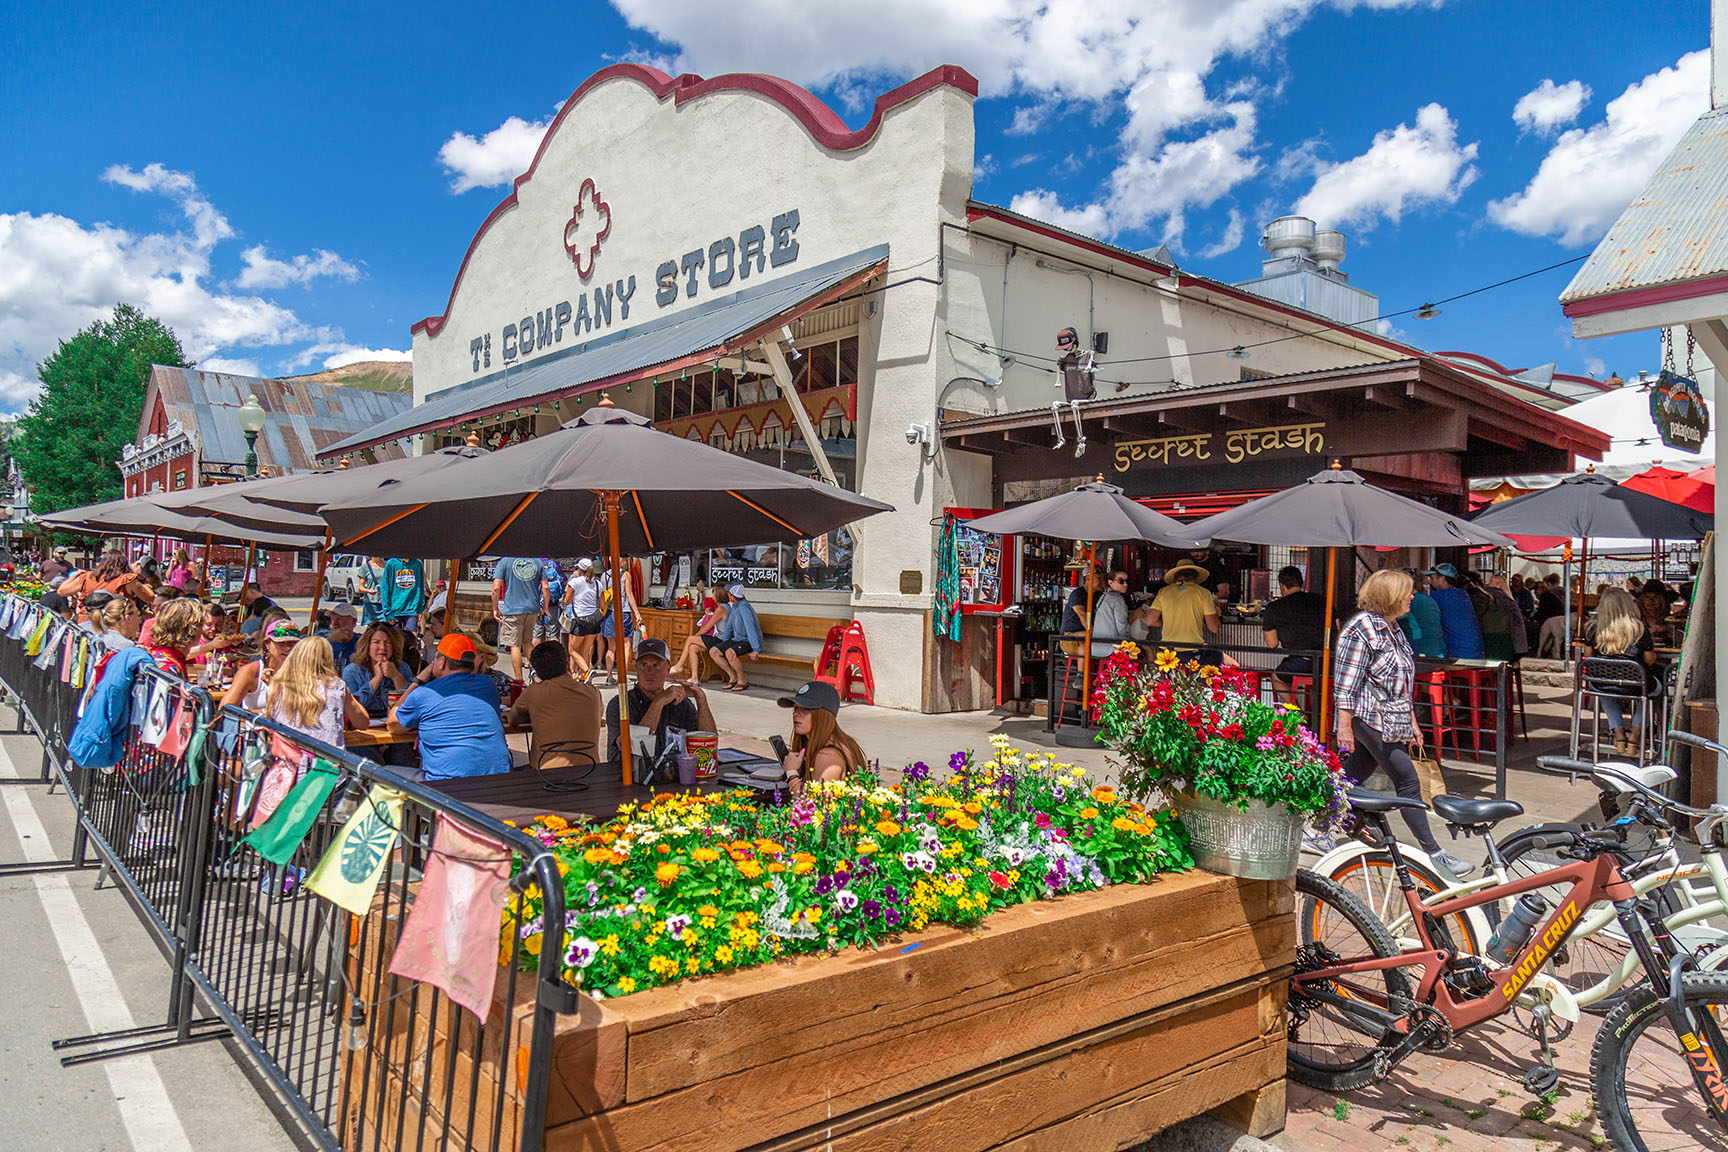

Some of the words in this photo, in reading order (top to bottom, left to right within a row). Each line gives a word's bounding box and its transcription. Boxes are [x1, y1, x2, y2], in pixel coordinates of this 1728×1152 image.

[502, 275, 636, 361] COMPANY
[656, 208, 801, 307] STORE
[1670, 421, 1701, 442] patagonia
[1502, 944, 1548, 1002] SANTA
[1542, 900, 1582, 950] CRUZ
